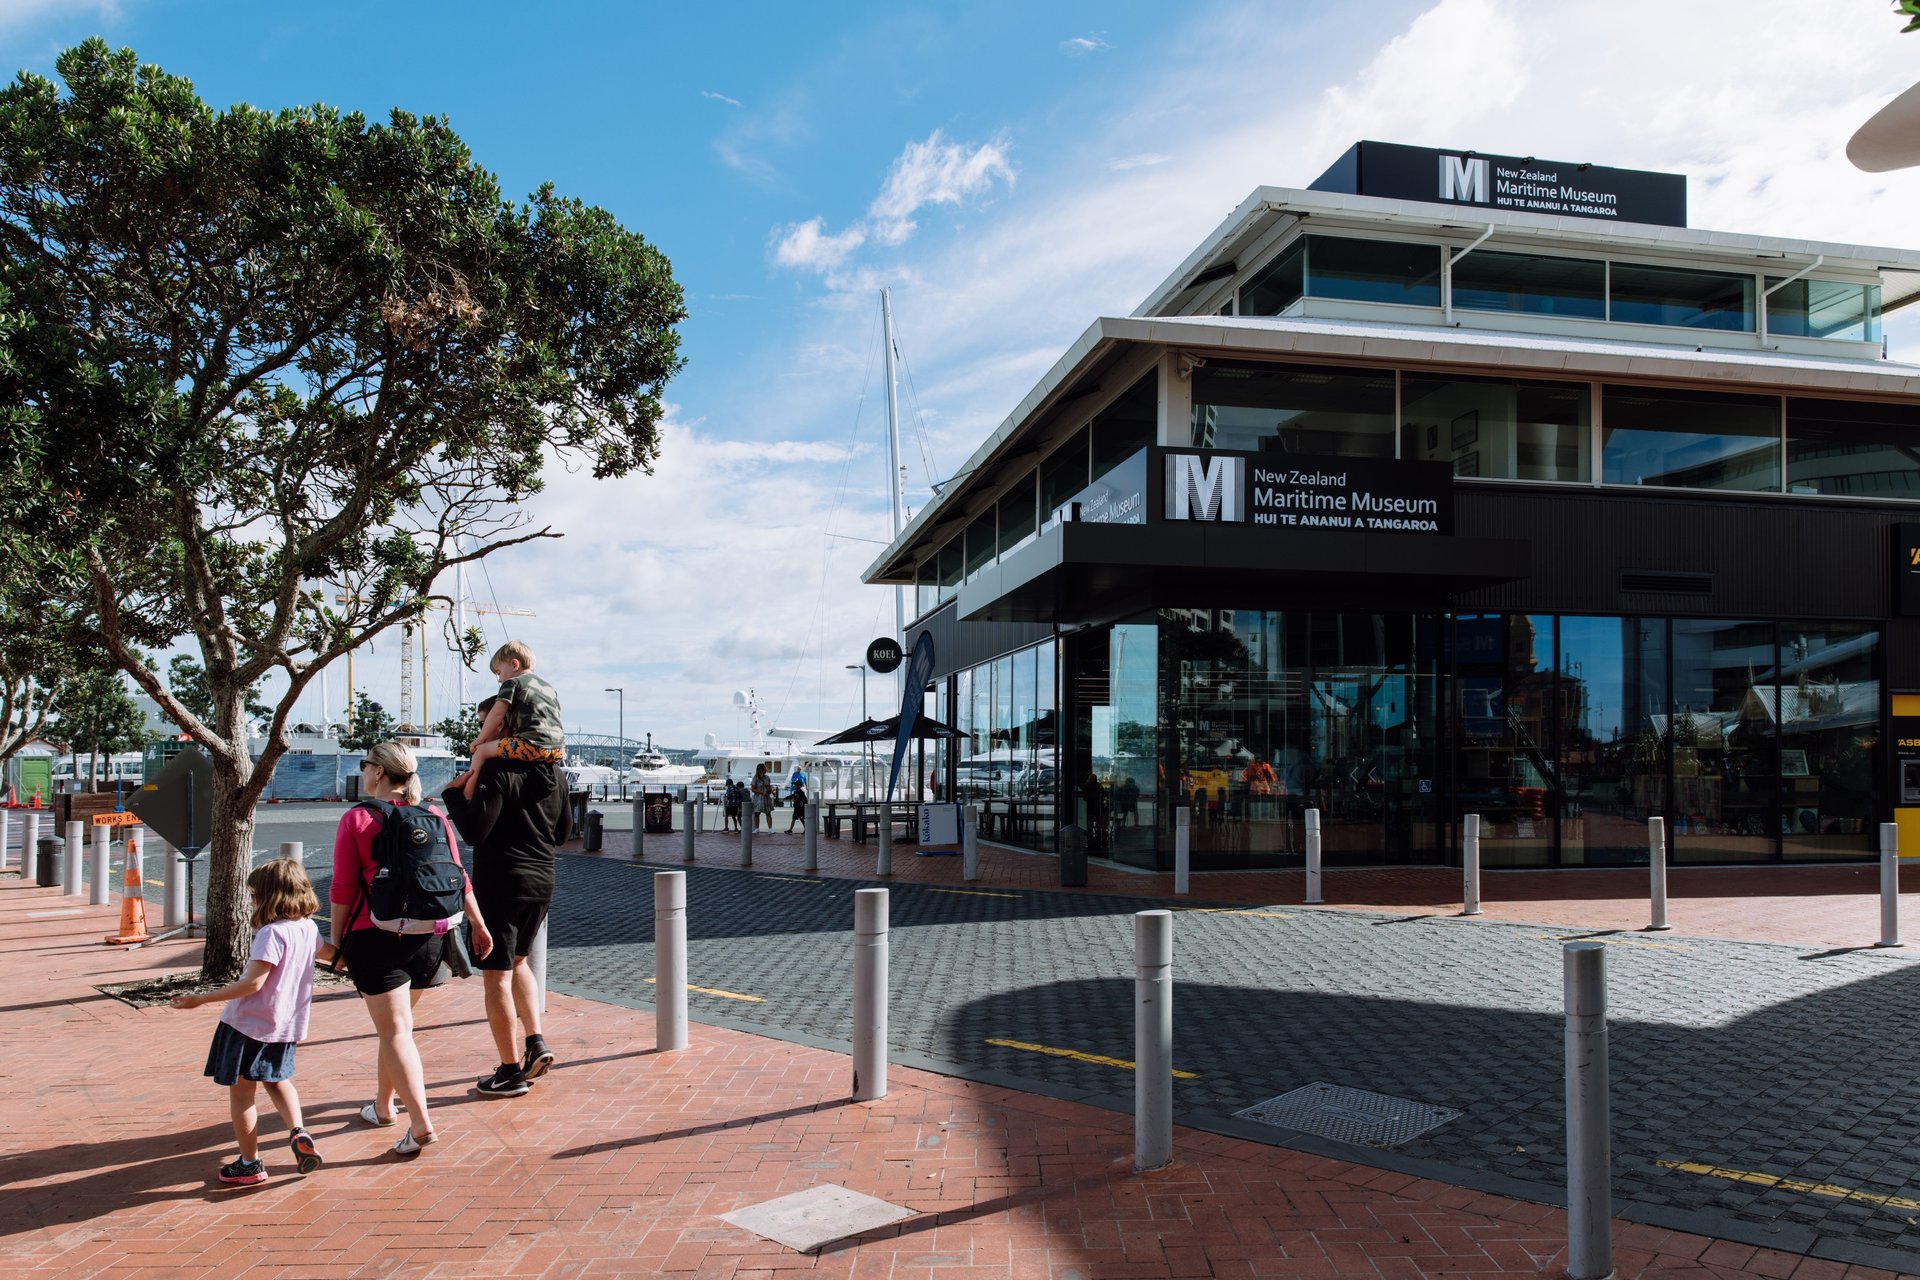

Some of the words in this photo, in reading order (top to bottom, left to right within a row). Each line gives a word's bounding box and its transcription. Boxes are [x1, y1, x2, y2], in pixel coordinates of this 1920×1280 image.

[1497, 167, 1519, 179] New
[1520, 170, 1557, 182] Zealand
[1497, 180, 1558, 199] Maritime
[1561, 186, 1617, 204] Museum
[1497, 197, 1512, 206] HUI
[1514, 199, 1525, 207] TE
[1527, 200, 1561, 211] ANANUI
[1562, 203, 1569, 211] A
[1571, 204, 1618, 216] TANGAROA
[1255, 469, 1287, 483] New
[1290, 471, 1346, 486] Zealand
[1090, 489, 1109, 512] Zealand
[1110, 492, 1140, 522] Museum
[1255, 487, 1347, 510] Maritime
[1353, 492, 1437, 514] Museum
[1255, 513, 1277, 524] HUI
[1281, 515, 1297, 525] TE
[1300, 516, 1351, 528] ANANUI
[1355, 518, 1365, 528] A
[1367, 519, 1438, 531] TANGAROA
[873, 649, 896, 659] KOEL
[1898, 738, 1920, 747] ASB
[95, 815, 122, 824] WORKS
